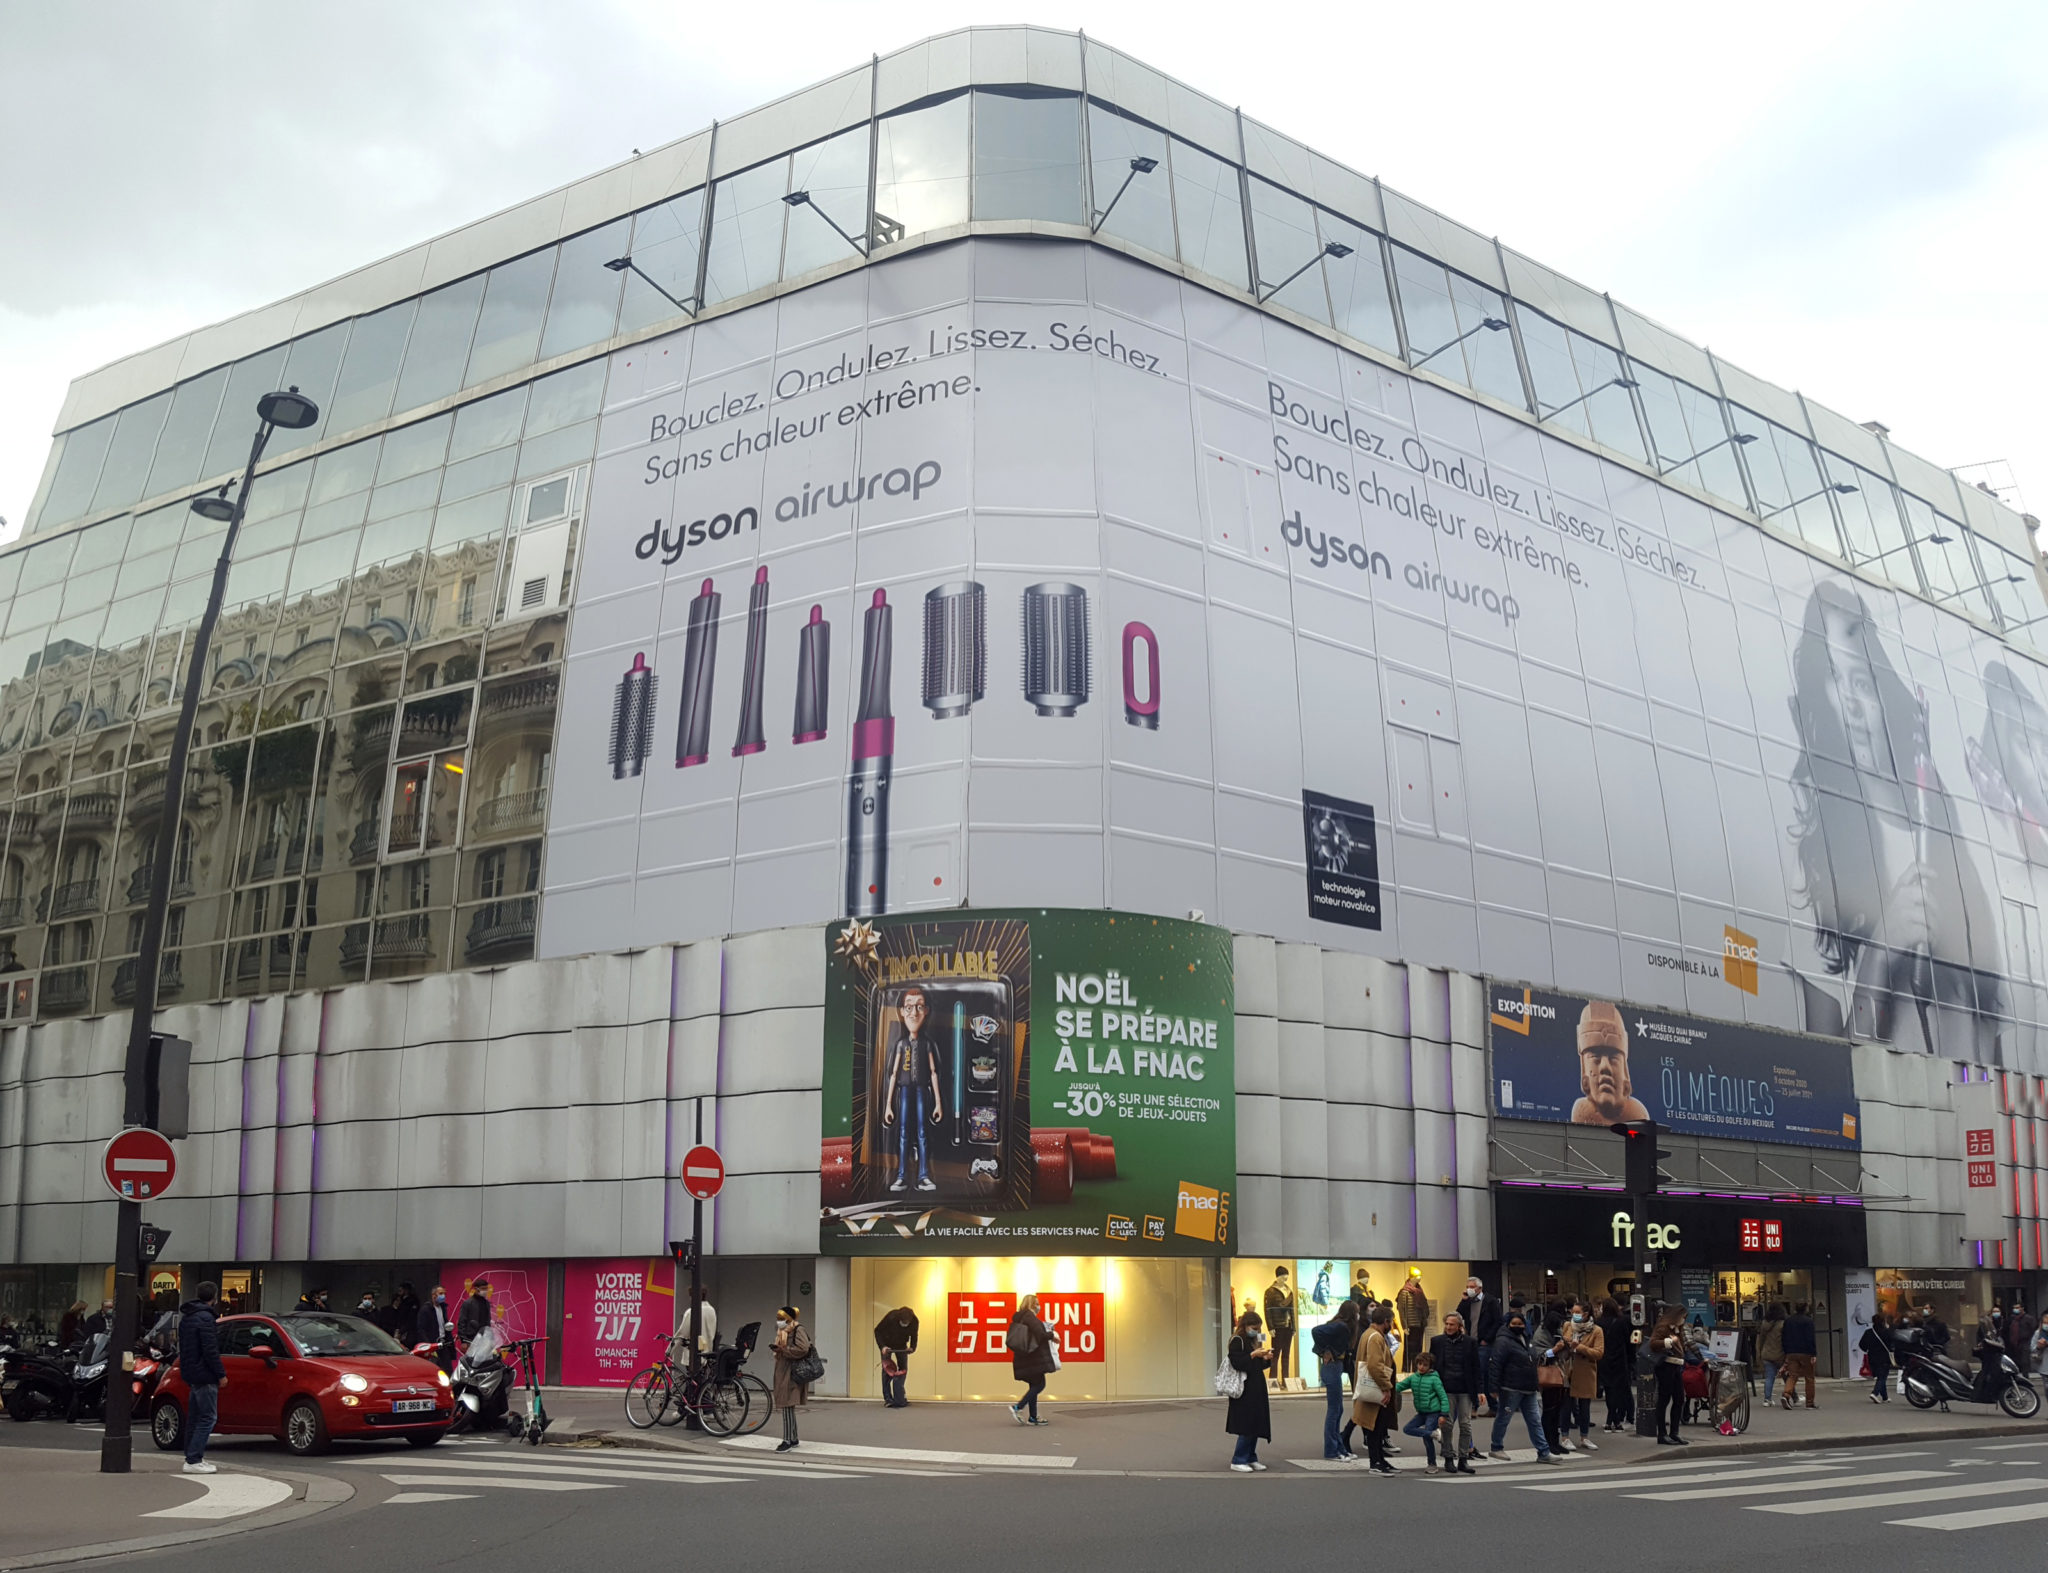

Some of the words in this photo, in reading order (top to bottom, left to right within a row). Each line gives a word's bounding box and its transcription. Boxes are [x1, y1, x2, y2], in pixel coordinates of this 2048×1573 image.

[650, 392, 764, 442] Bouclez.
[776, 343, 917, 399] Ondulez.
[929, 325, 1037, 357] Lissez.
[1049, 322, 1168, 377] Séchez.
[644, 449, 712, 485] Sans
[720, 411, 831, 462] chaleur
[838, 374, 981, 426] extrême.
[1268, 381, 1394, 461] Bouclez.
[1402, 437, 1530, 516] Ondulez.
[1534, 490, 1614, 552] Lissez.
[1618, 526, 1706, 590] Séchez.
[635, 506, 758, 565] dyson
[774, 460, 942, 522] airwrap
[1273, 435, 1350, 495] Sans
[1358, 471, 1466, 539] chaleur
[1474, 525, 1589, 588] extrême.
[1280, 510, 1392, 580] dyson
[1404, 561, 1520, 627] airwrap
[1321, 880, 1366, 899] technologie
[1313, 894, 1340, 907] moteur
[1341, 900, 1376, 913] novatrice
[1724, 936, 1759, 960] fnac
[877, 950, 998, 988] L'INCOLLABLE
[1647, 953, 1699, 974] DISPONIBLE
[1700, 961, 1707, 976] À
[1708, 966, 1719, 978] LA
[1055, 969, 1137, 1007] NOËL
[1497, 999, 1556, 1019] EXPOSITION
[1055, 1009, 1092, 1039] SE
[1101, 1006, 1218, 1049] PRÉPARE
[1649, 1022, 1667, 1033] MUSÉE
[1668, 1025, 1675, 1034] DU
[1676, 1026, 1687, 1035] QUAI
[1688, 1029, 1707, 1039] BRANLY
[1650, 1031, 1672, 1042] JACQUES
[1674, 1035, 1692, 1045] CHIRAC
[1054, 1038, 1078, 1072] À
[1087, 1046, 1125, 1075] LA
[1133, 1048, 1205, 1081] FNAC
[1660, 1056, 1675, 1067] LES
[1068, 1082, 1100, 1091] JUSQU'À
[1661, 1064, 1775, 1116] OLMÈQUES
[1053, 1090, 1117, 1117] -30%
[1118, 1092, 1141, 1104] SUR
[1143, 1094, 1165, 1106] UNE
[1167, 1093, 1220, 1110] SÉLECTION
[1118, 1106, 1134, 1118] DE
[1136, 1108, 1207, 1122] JEUX-JOUETS
[1667, 1110, 1673, 1118] ET
[1675, 1111, 1686, 1119] LES
[1687, 1112, 1715, 1122] CULTURES
[1717, 1115, 1724, 1123] DU
[1725, 1116, 1742, 1125] GOLFE
[1743, 1118, 1751, 1126] DU
[1752, 1119, 1775, 1128] MEXIQUE
[1971, 1164, 1990, 1174] UNI
[1972, 1175, 1993, 1185] QLO
[1177, 1191, 1218, 1210] fnac
[924, 1227, 935, 1236] LA
[937, 1227, 951, 1236] VIE
[953, 1227, 984, 1236] FACILE
[986, 1227, 1010, 1236] AVEC
[1012, 1227, 1028, 1236] LES
[1030, 1227, 1073, 1236] SERVICES
[1075, 1227, 1100, 1236] FNAC
[1110, 1221, 1134, 1229] CLICK
[1149, 1221, 1164, 1230] PAY
[1766, 1224, 1779, 1235] UNI
[1766, 1236, 1780, 1249] QLO
[153, 1281, 175, 1289] DARTY
[596, 1273, 642, 1289] VOTRE
[1913, 1280, 1924, 1289] BON
[1944, 1280, 1965, 1289] CURIEUX
[595, 1289, 642, 1300] MAGASIN
[595, 1302, 642, 1314] OUVERT
[957, 1301, 1007, 1324] ユニ
[1044, 1302, 1091, 1325] UNI
[595, 1316, 642, 1341] 7J/7
[955, 1330, 1007, 1353] クロ
[595, 1348, 638, 1358] DIMANCHE
[600, 1359, 611, 1368] 11H
[620, 1359, 633, 1369] 19H
